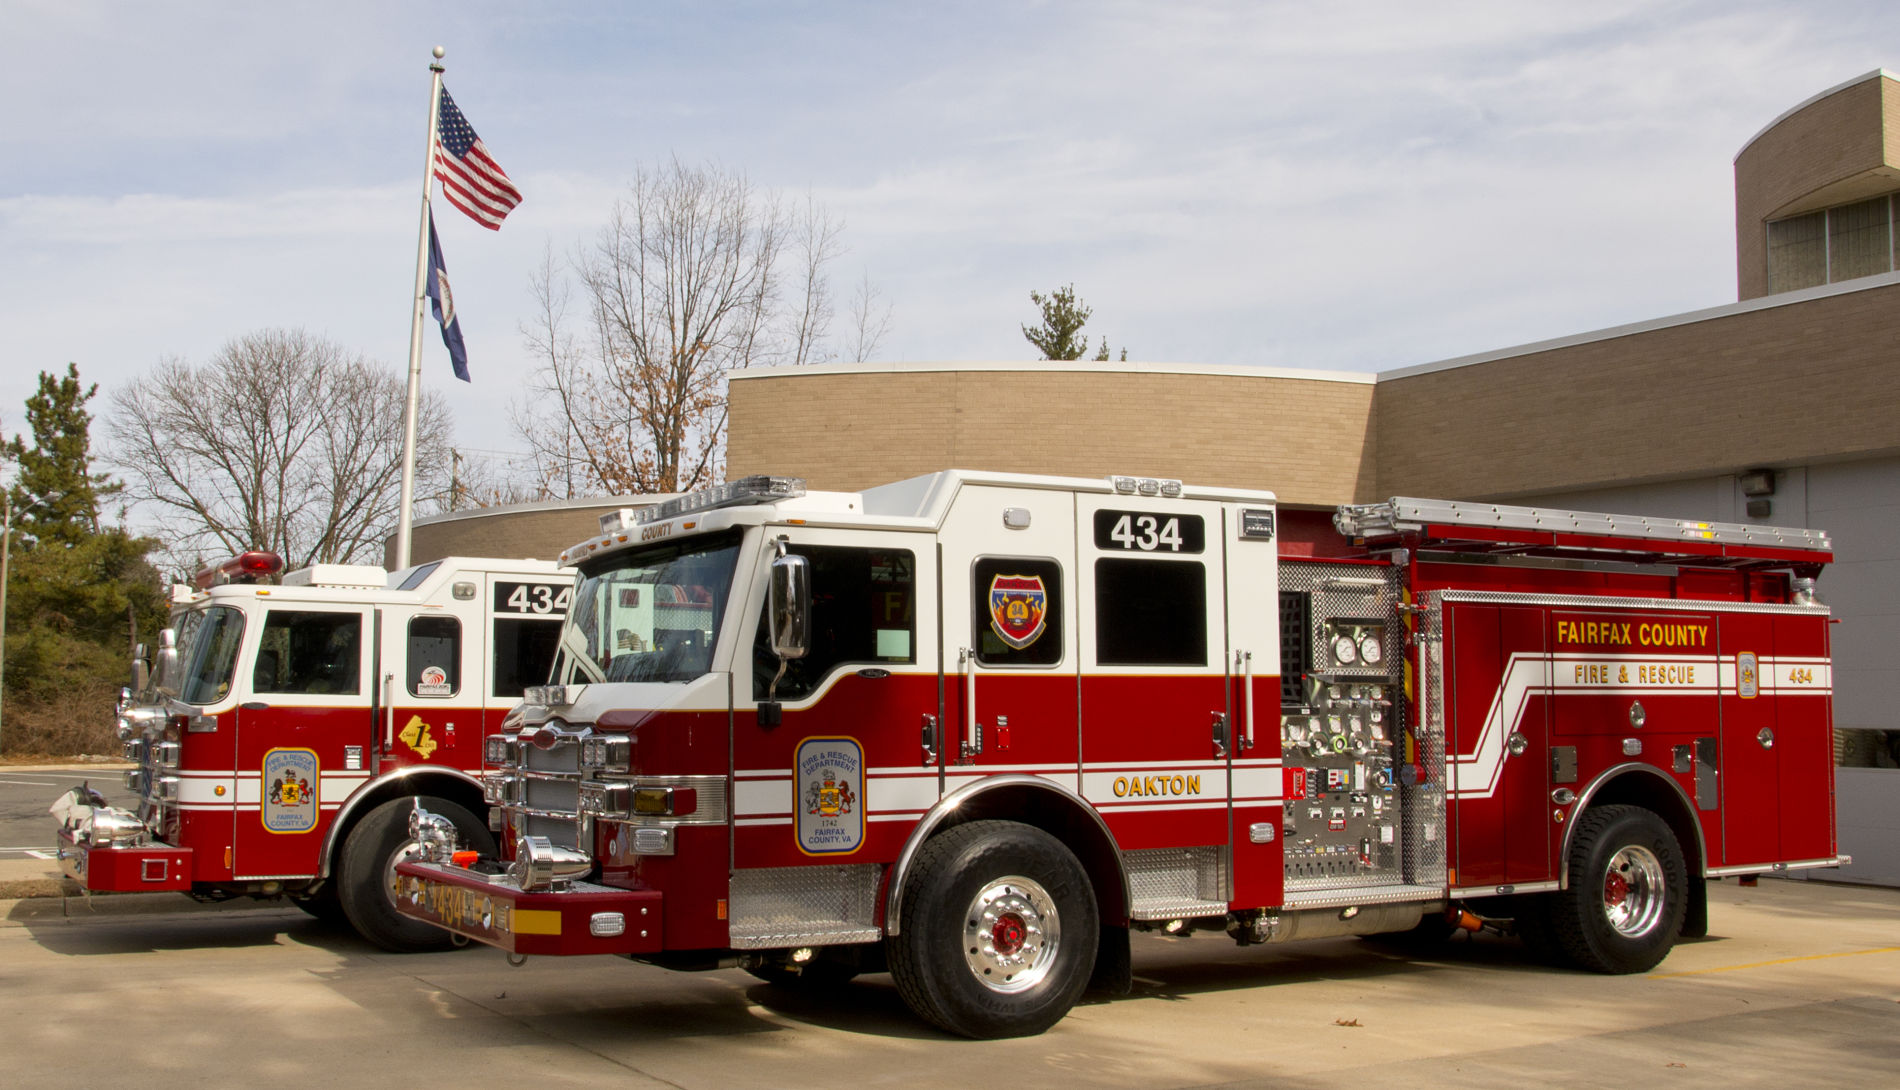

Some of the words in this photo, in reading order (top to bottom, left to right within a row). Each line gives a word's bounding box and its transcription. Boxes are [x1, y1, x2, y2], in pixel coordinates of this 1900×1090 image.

[641, 521, 674, 541] COUNTY
[1111, 515, 1183, 551] 434
[508, 584, 574, 614] 434
[1011, 603, 1024, 616] 34
[1557, 621, 1632, 646] FAIRFAX
[1639, 623, 1708, 647] COUNTY
[1574, 664, 1609, 684] FIRE
[1618, 664, 1629, 684] &
[1639, 665, 1695, 685] RESCUE
[1789, 668, 1813, 684] 434
[412, 724, 426, 749] 1
[802, 755, 819, 769] FIRE
[820, 752, 826, 760] &
[827, 751, 857, 767] RESCUE
[805, 759, 855, 776] DEPARTMENT
[1113, 774, 1201, 798] OAKTON
[814, 828, 846, 836] FAIRFAX
[842, 835, 852, 843] VA
[438, 885, 462, 929] 434
